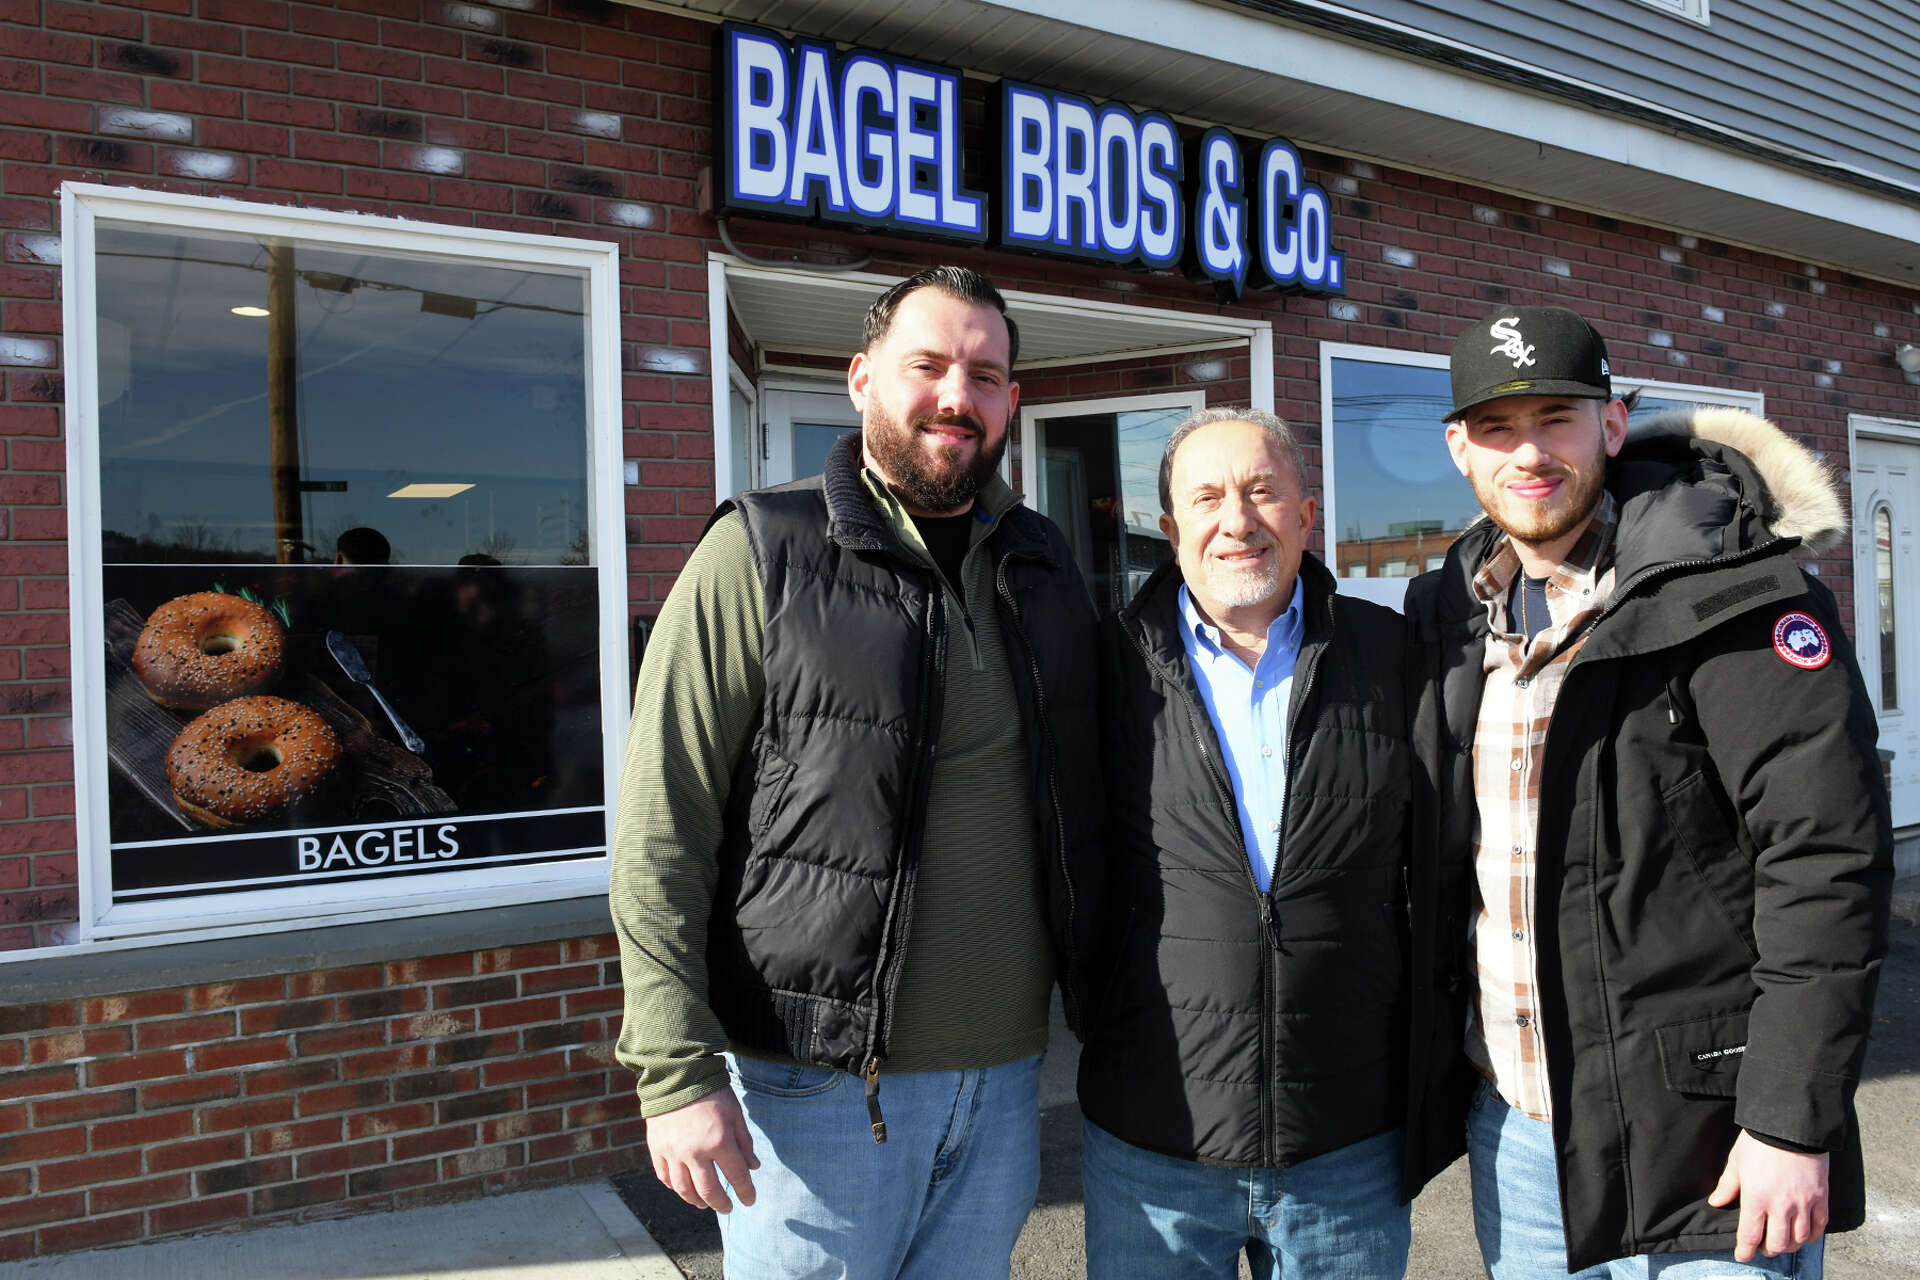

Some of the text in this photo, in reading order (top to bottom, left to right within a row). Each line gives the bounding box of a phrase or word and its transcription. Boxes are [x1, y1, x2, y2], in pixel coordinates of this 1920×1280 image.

[735, 36, 1341, 288] BAGEL BROS & Co.
[298, 825, 459, 871] BAGELS
[1697, 1050, 1722, 1060] CANADA
